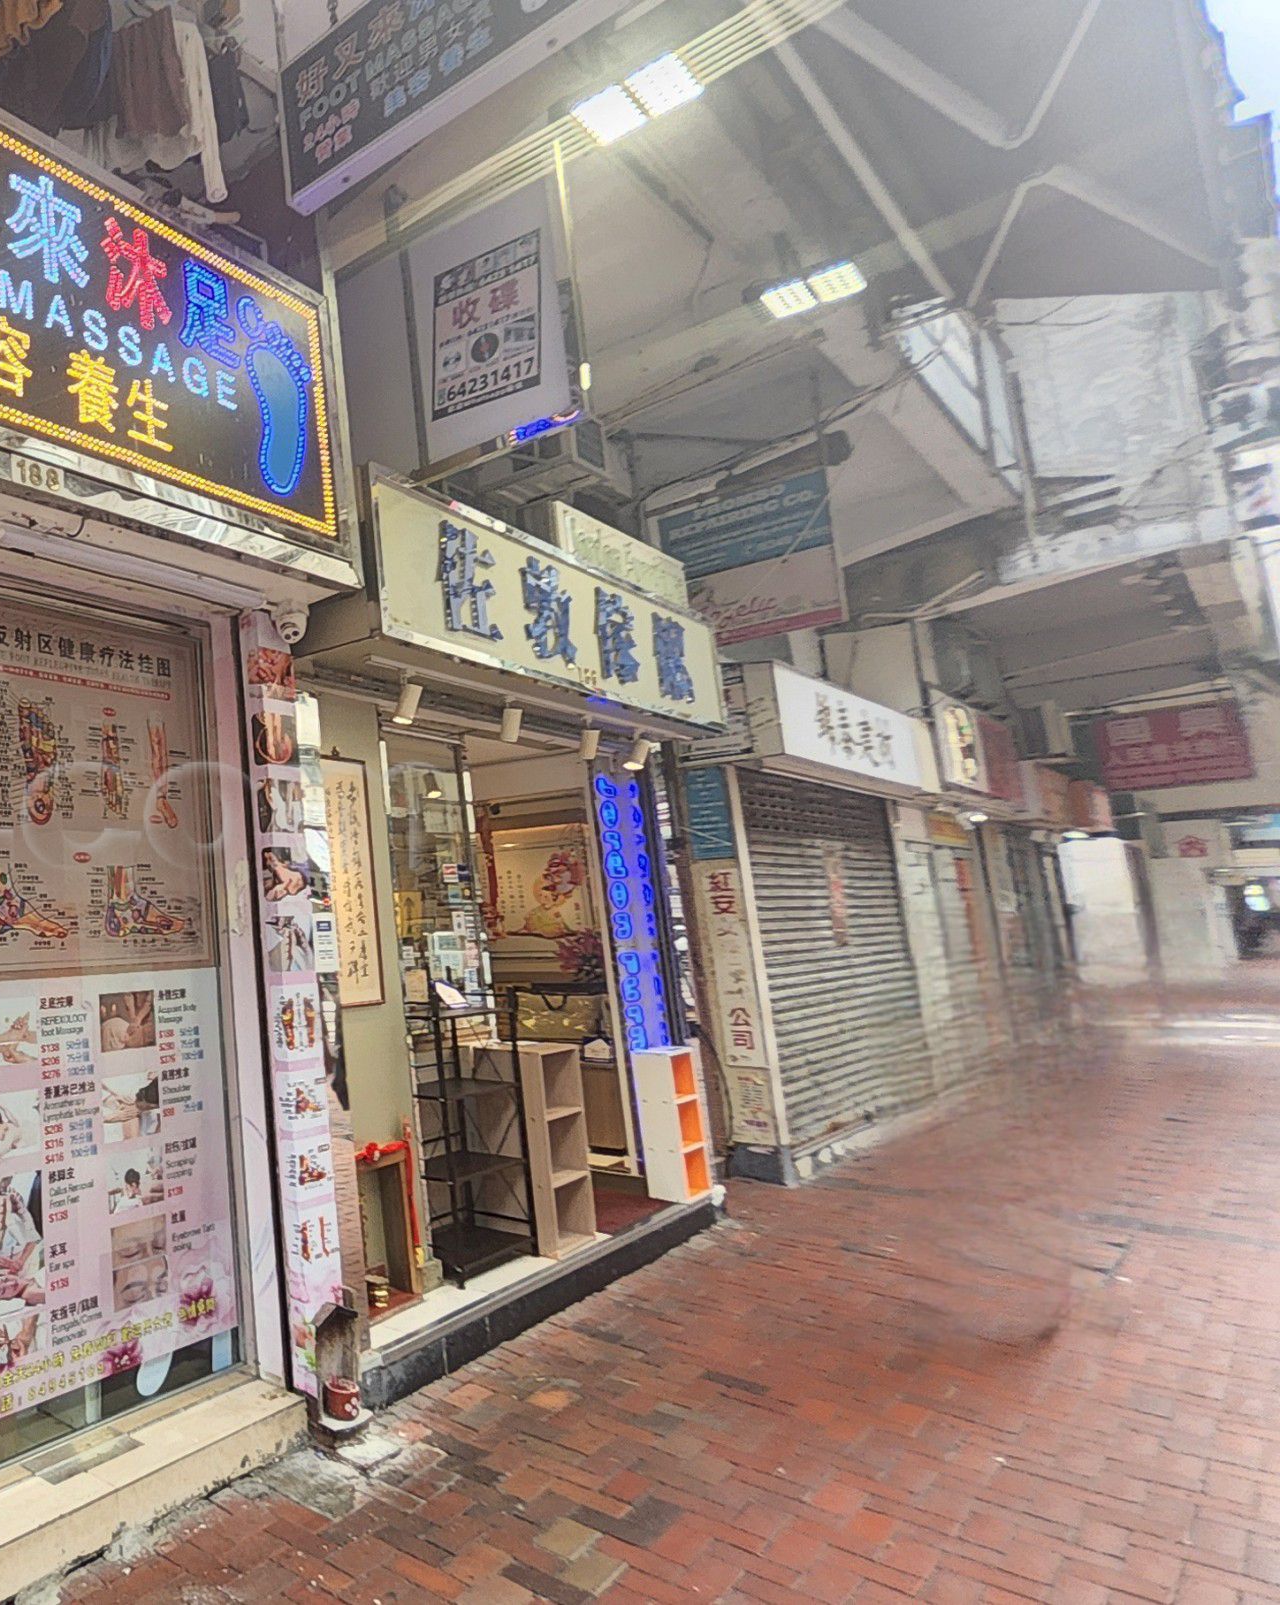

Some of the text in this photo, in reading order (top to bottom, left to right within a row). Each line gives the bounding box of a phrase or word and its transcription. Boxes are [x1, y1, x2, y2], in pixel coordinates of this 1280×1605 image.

[299, 69, 361, 131] FOOT
[65, 348, 174, 454] 養生
[447, 356, 535, 402] 64231417
[16, 458, 60, 492] 188
